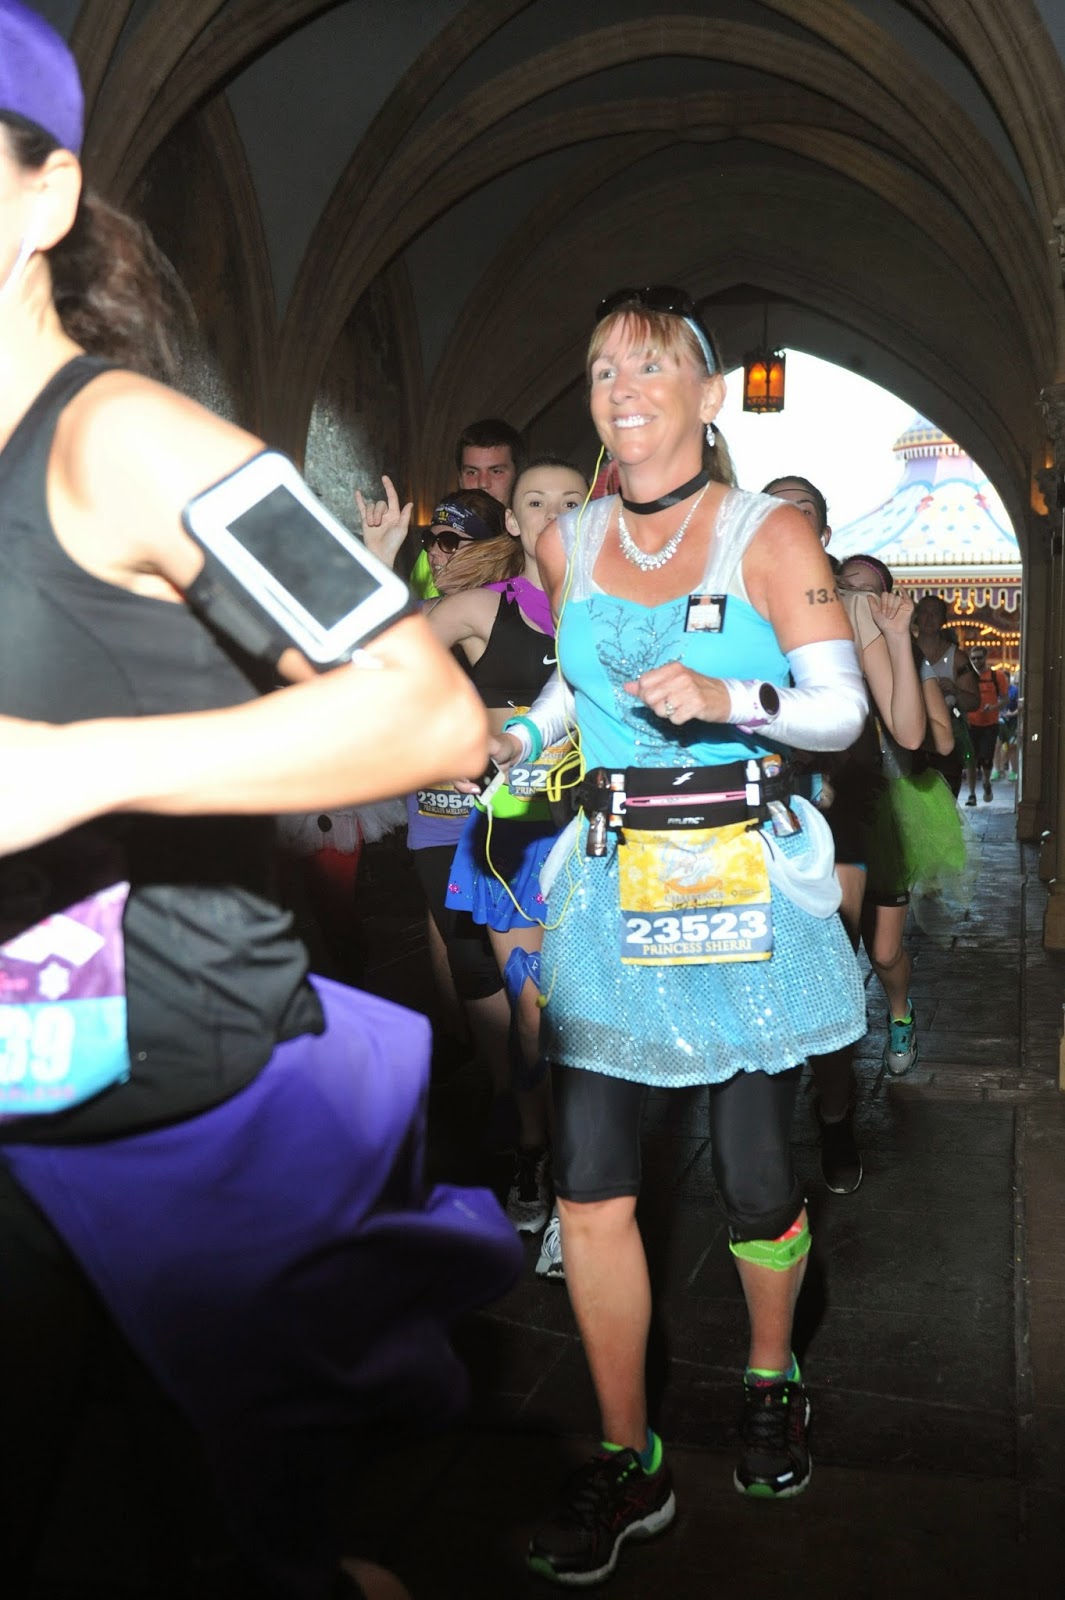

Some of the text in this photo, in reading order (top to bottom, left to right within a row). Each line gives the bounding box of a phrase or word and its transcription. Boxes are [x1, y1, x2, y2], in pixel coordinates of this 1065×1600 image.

[516, 787, 537, 795] PRIN
[417, 791, 475, 809] 23954
[626, 911, 768, 944] 23523
[643, 939, 751, 956] PRINCESS SHERRI
